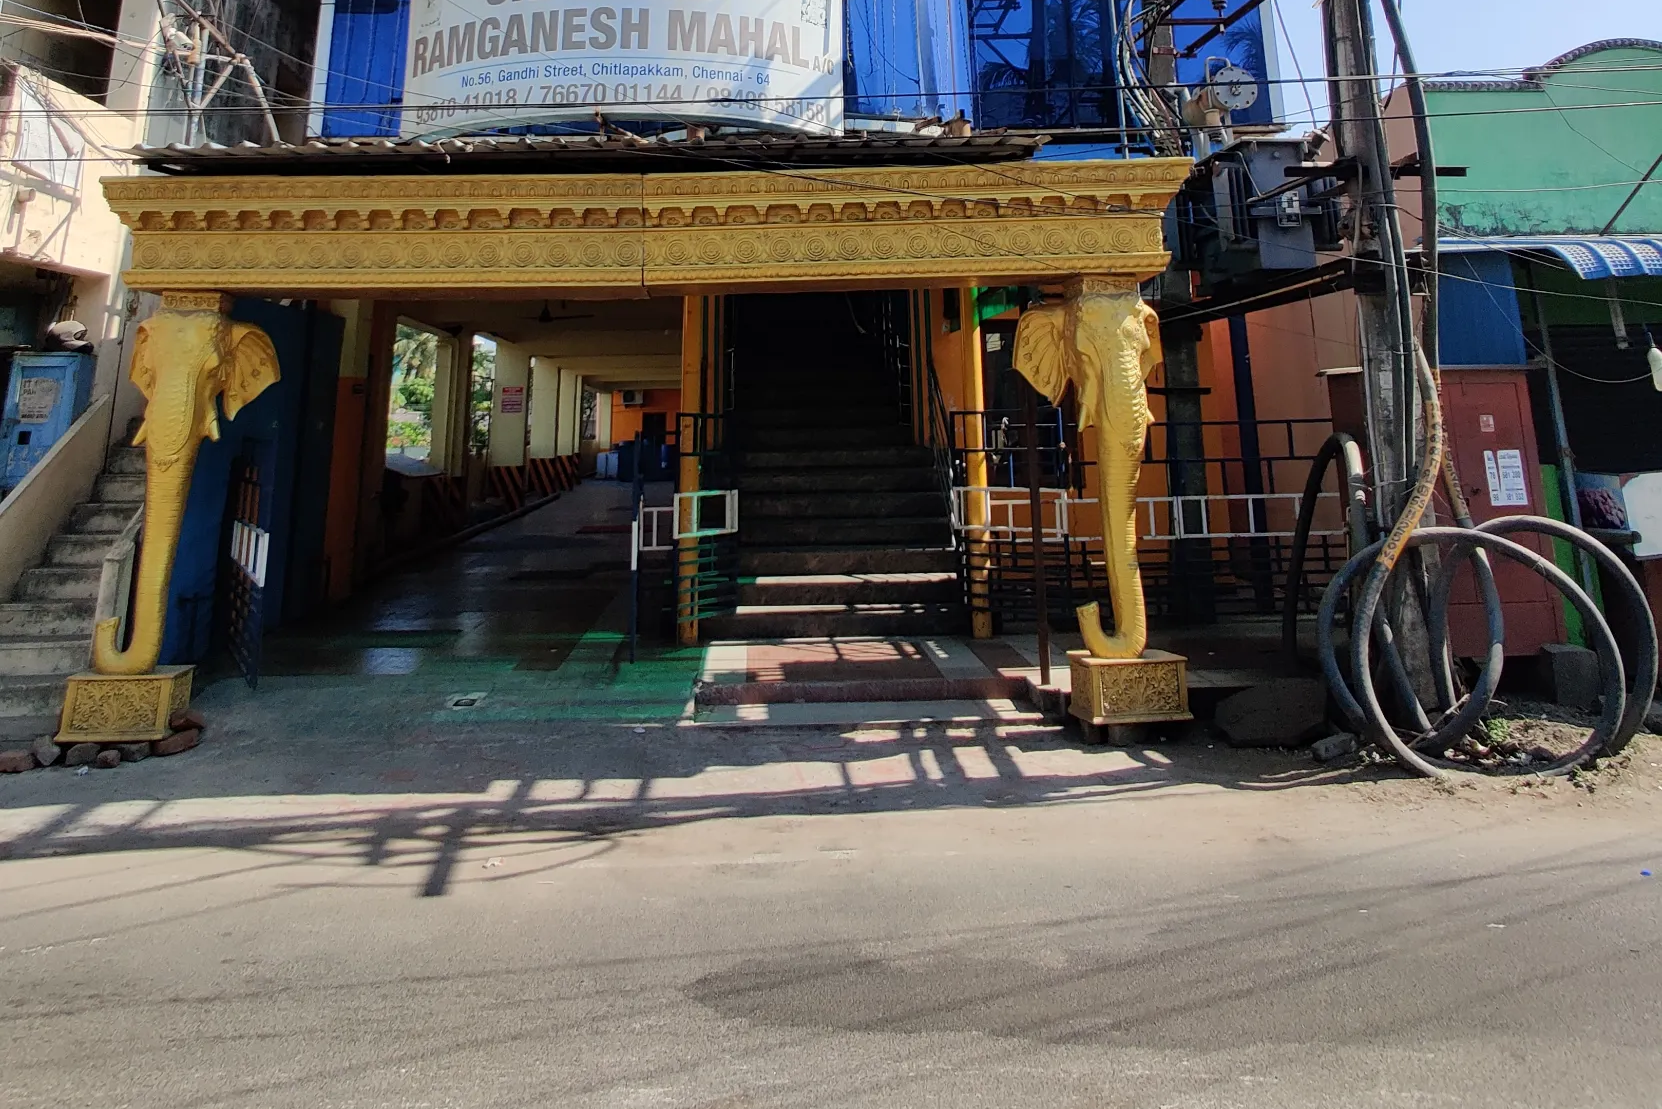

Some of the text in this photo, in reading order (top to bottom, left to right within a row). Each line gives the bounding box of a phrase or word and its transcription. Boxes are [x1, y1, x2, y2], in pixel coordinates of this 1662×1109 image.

[413, 8, 650, 78] RAMGANESH
[668, 9, 810, 69] MAHAL
[461, 72, 494, 88] No.56,
[498, 66, 539, 82] Gandhi
[544, 63, 587, 78] Street,
[592, 62, 688, 79] Chitlapakkam,
[692, 65, 743, 82] Chennai
[756, 72, 770, 86] 64
[540, 83, 607, 104] 76670
[614, 83, 683, 102] 01144
